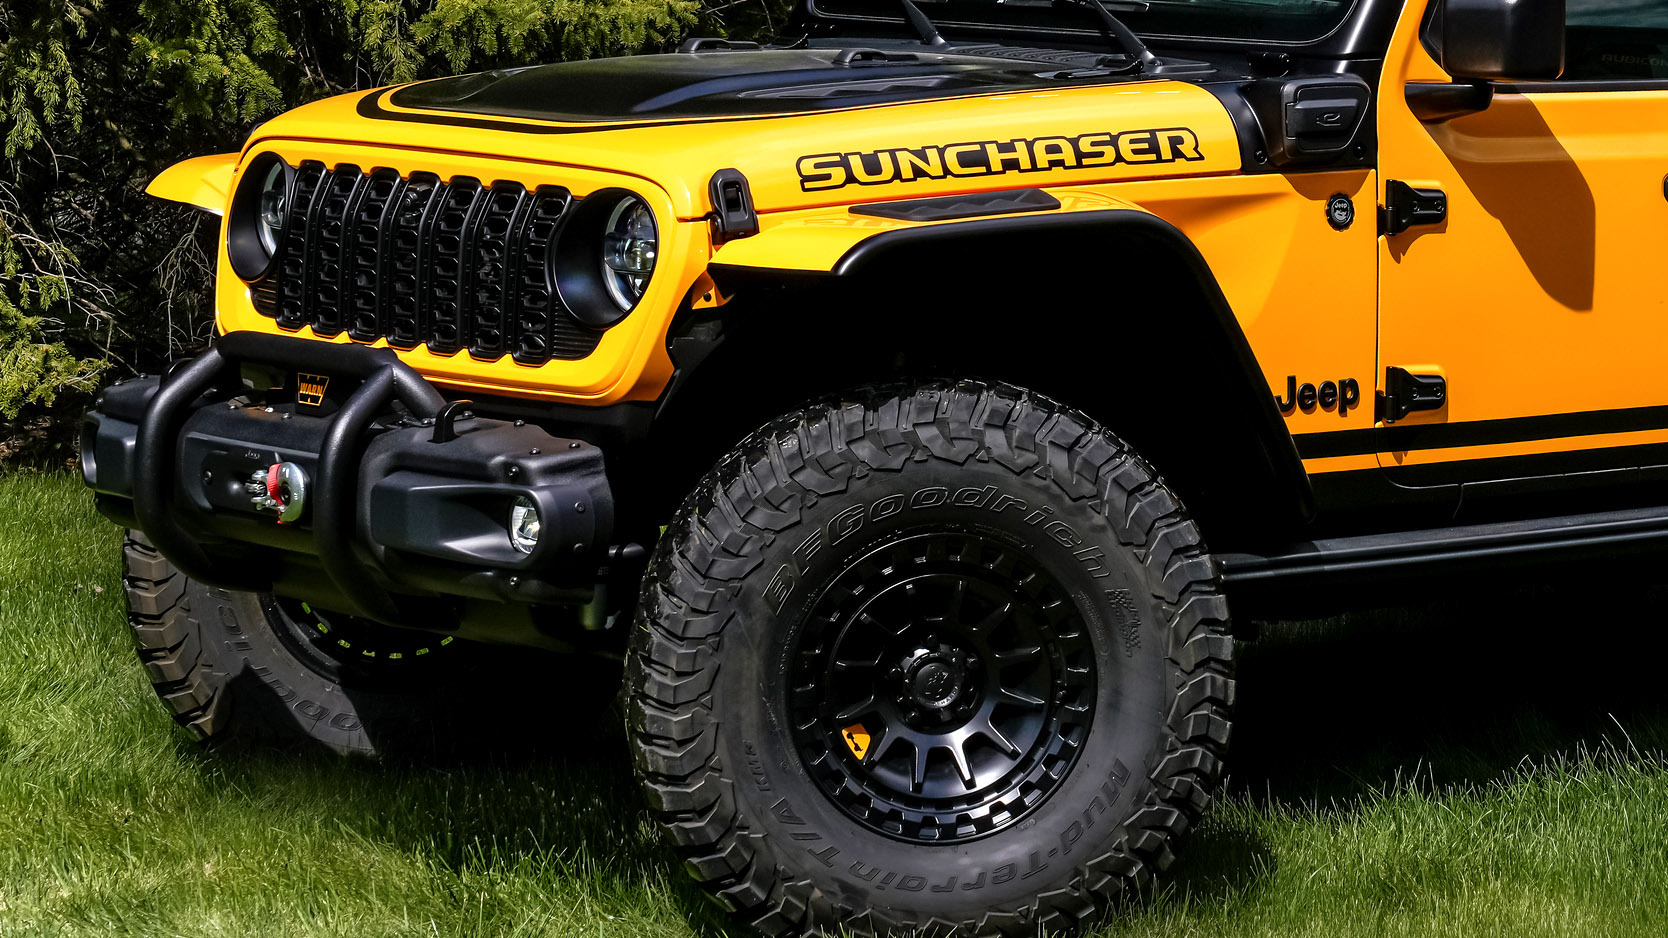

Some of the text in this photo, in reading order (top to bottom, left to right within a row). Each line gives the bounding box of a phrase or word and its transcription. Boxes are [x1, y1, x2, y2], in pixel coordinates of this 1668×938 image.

[796, 127, 1205, 192] SUNCHASER
[300, 382, 324, 395] WARN
[1274, 375, 1360, 415] Jeep
[761, 485, 1111, 616] BFGoodrich
[770, 796, 840, 868] T/A
[848, 757, 1132, 893] Mud-Terrain
